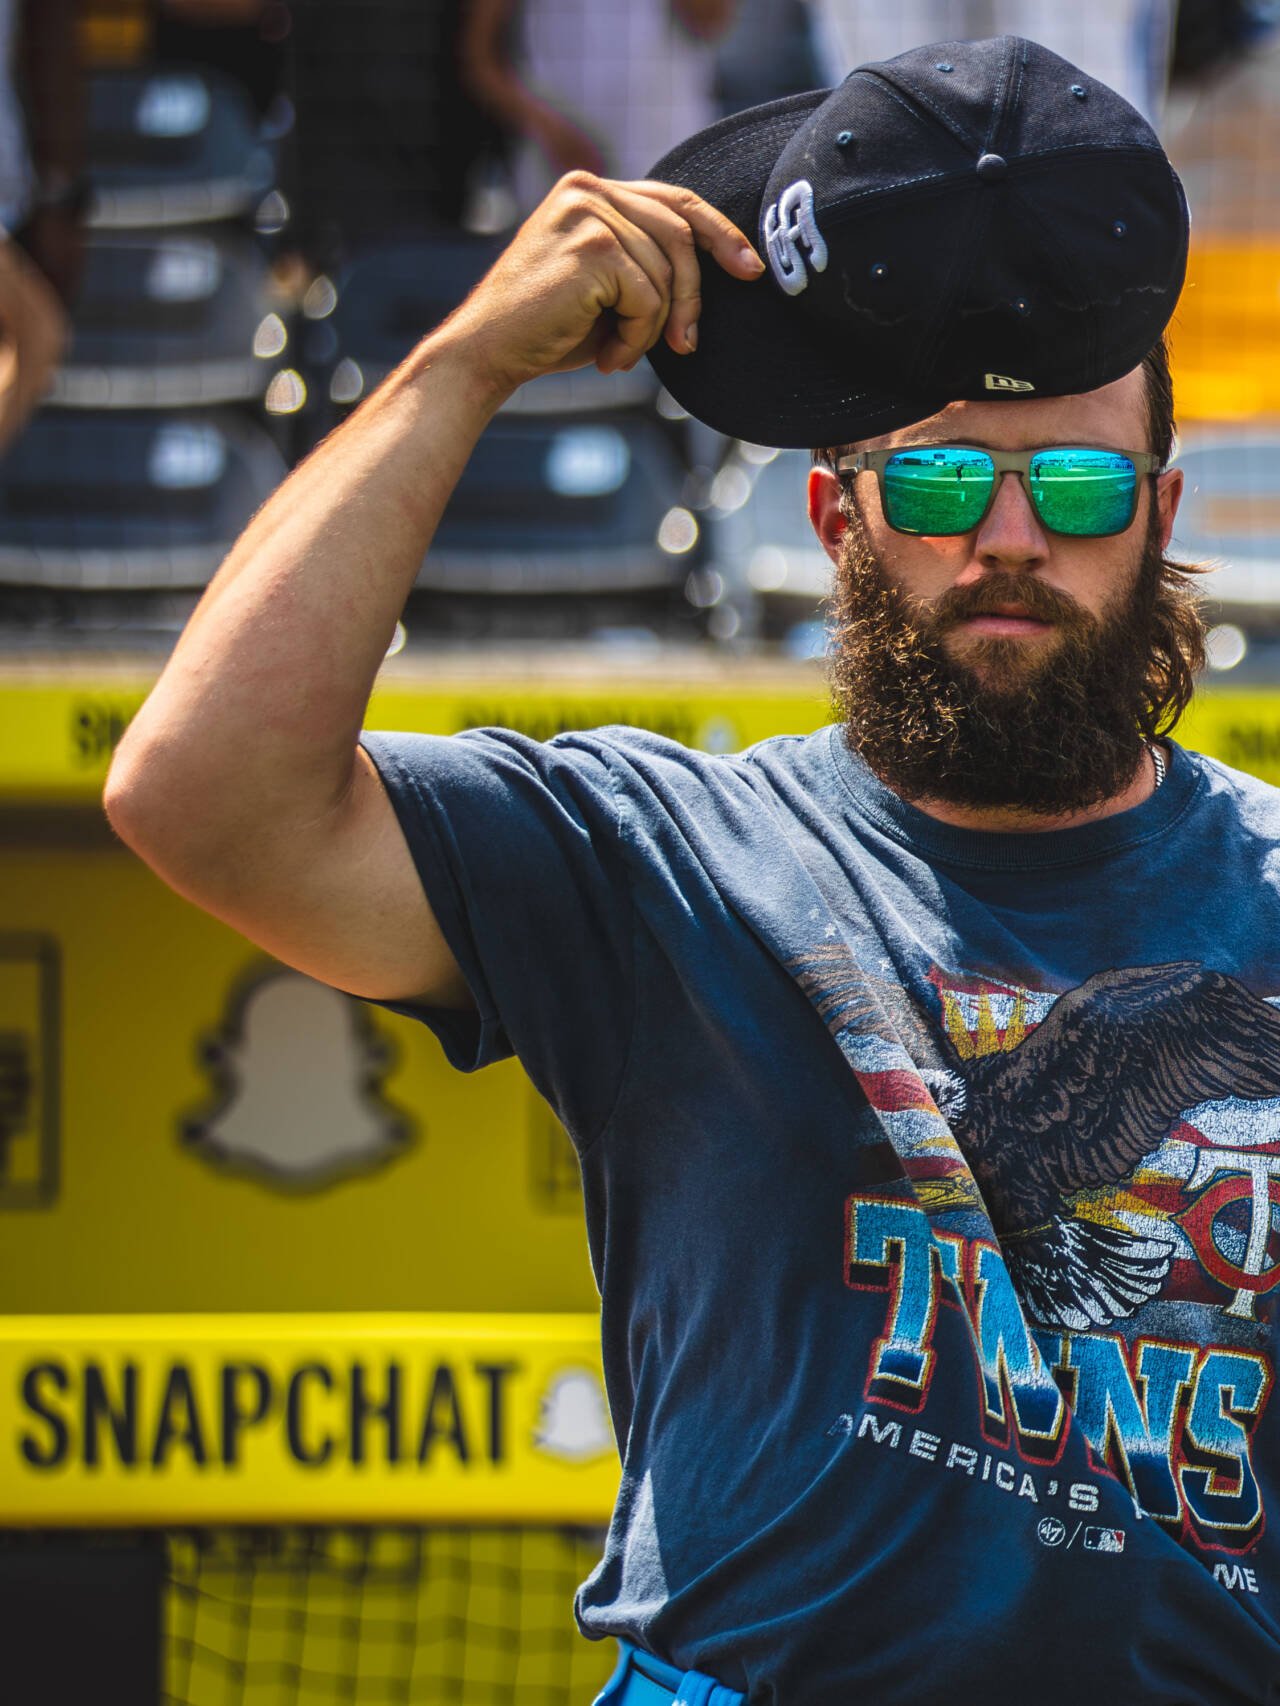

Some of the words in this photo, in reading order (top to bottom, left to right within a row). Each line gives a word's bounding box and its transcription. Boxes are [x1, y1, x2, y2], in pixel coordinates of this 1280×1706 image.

[17, 1358, 522, 1472] SNAPCHAT
[844, 1193, 1276, 1555] TWNS
[827, 1413, 1100, 1512] AMERICA'S
